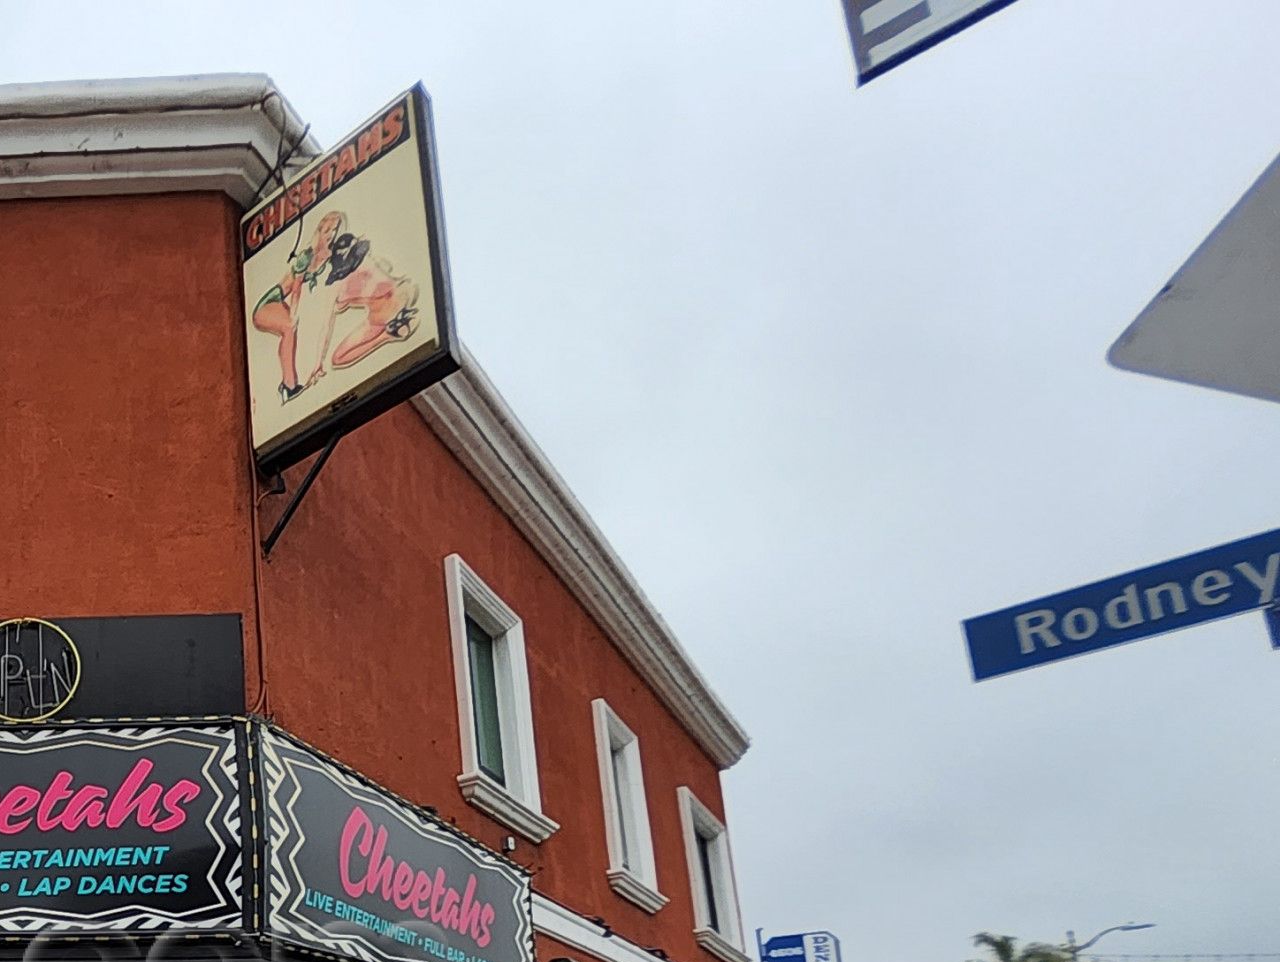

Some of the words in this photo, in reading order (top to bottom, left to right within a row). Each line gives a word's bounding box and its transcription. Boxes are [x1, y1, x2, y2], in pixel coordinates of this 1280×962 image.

[245, 104, 405, 248] CHEETAHS
[1014, 551, 1280, 655] Rodney
[17, 876, 72, 897] LAP
[77, 873, 188, 896] DANCES
[304, 887, 333, 914] LIVE
[334, 901, 419, 946] ENTERTAINMENT
[424, 937, 446, 960] FULL
[338, 805, 496, 948] Cheetahs
